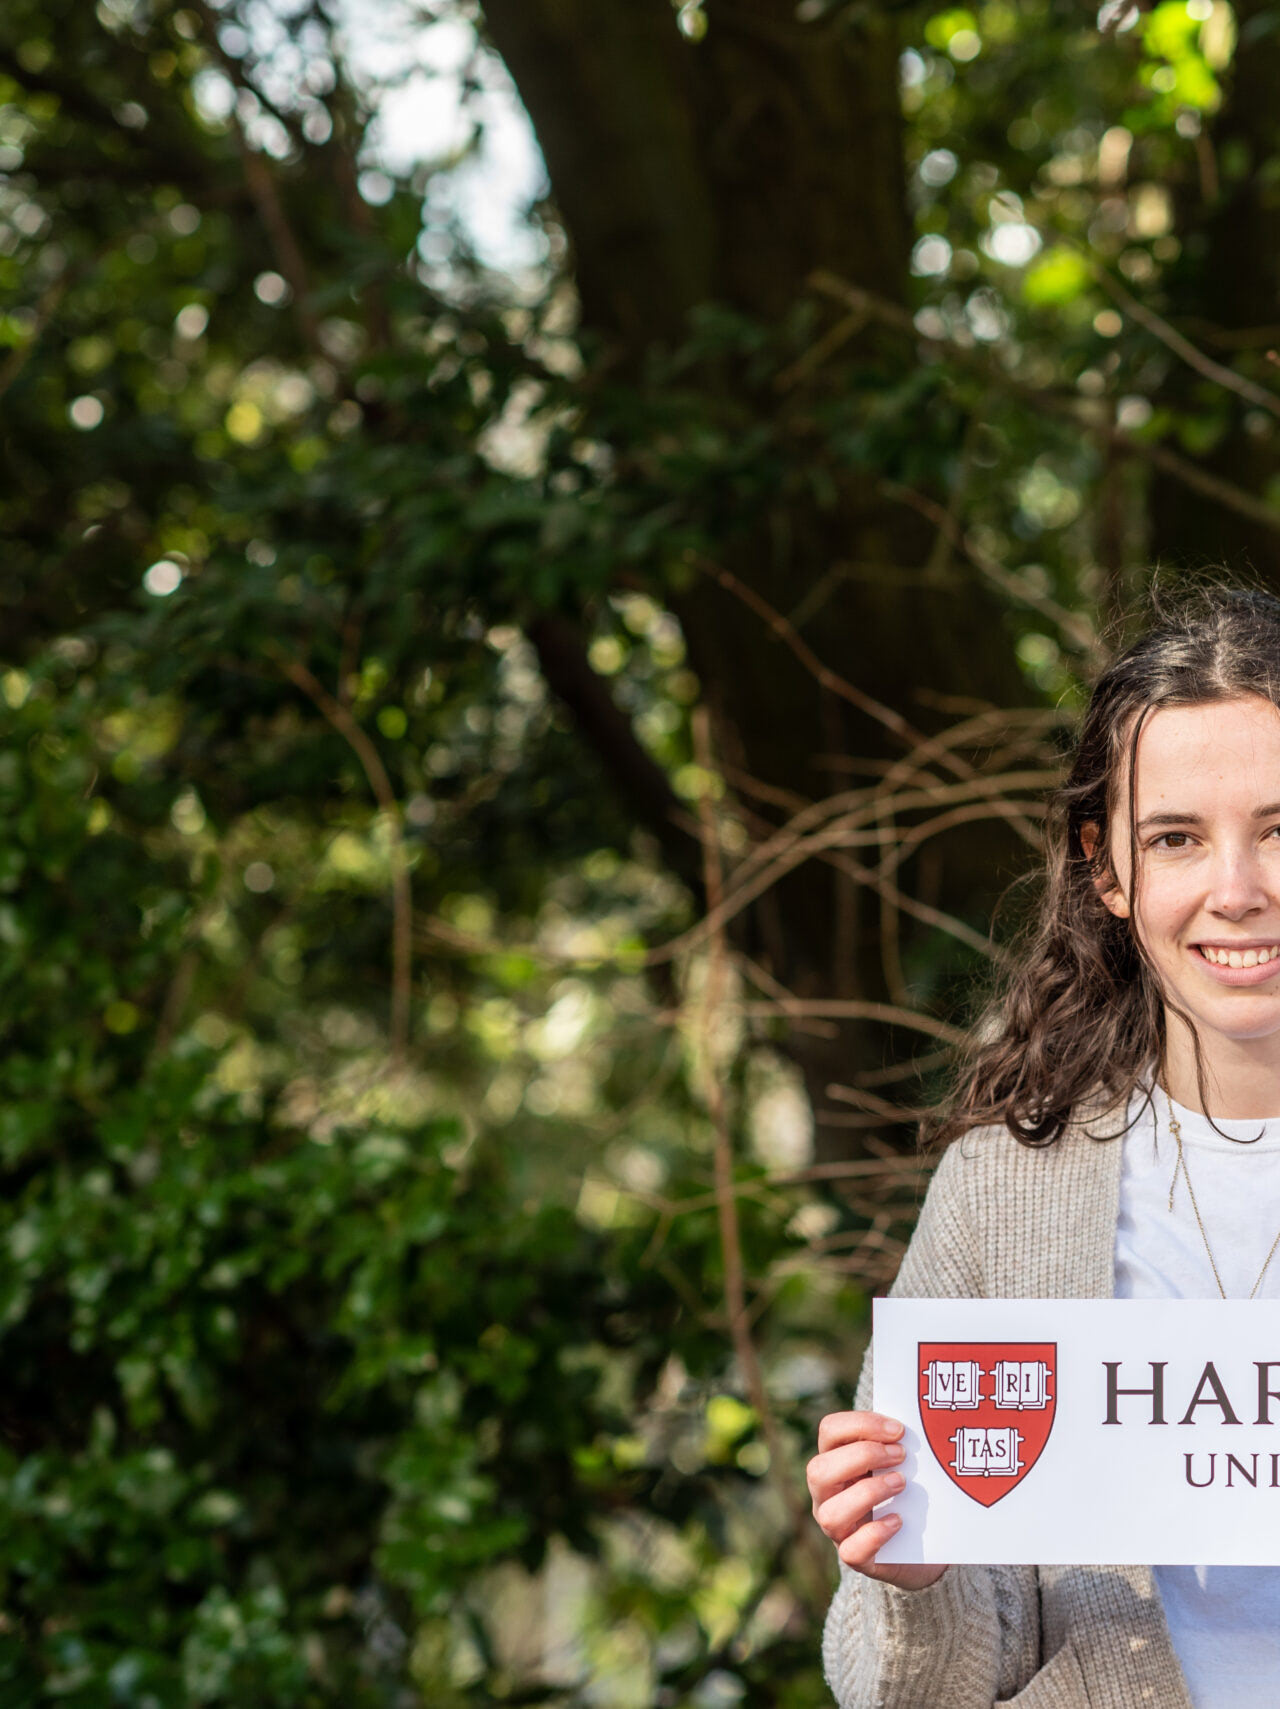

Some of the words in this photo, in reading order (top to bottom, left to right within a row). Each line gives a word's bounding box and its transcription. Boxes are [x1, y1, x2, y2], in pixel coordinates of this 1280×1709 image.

[938, 1373, 967, 1392] VE
[1006, 1373, 1031, 1392] RI
[968, 1438, 1006, 1457] TAS
